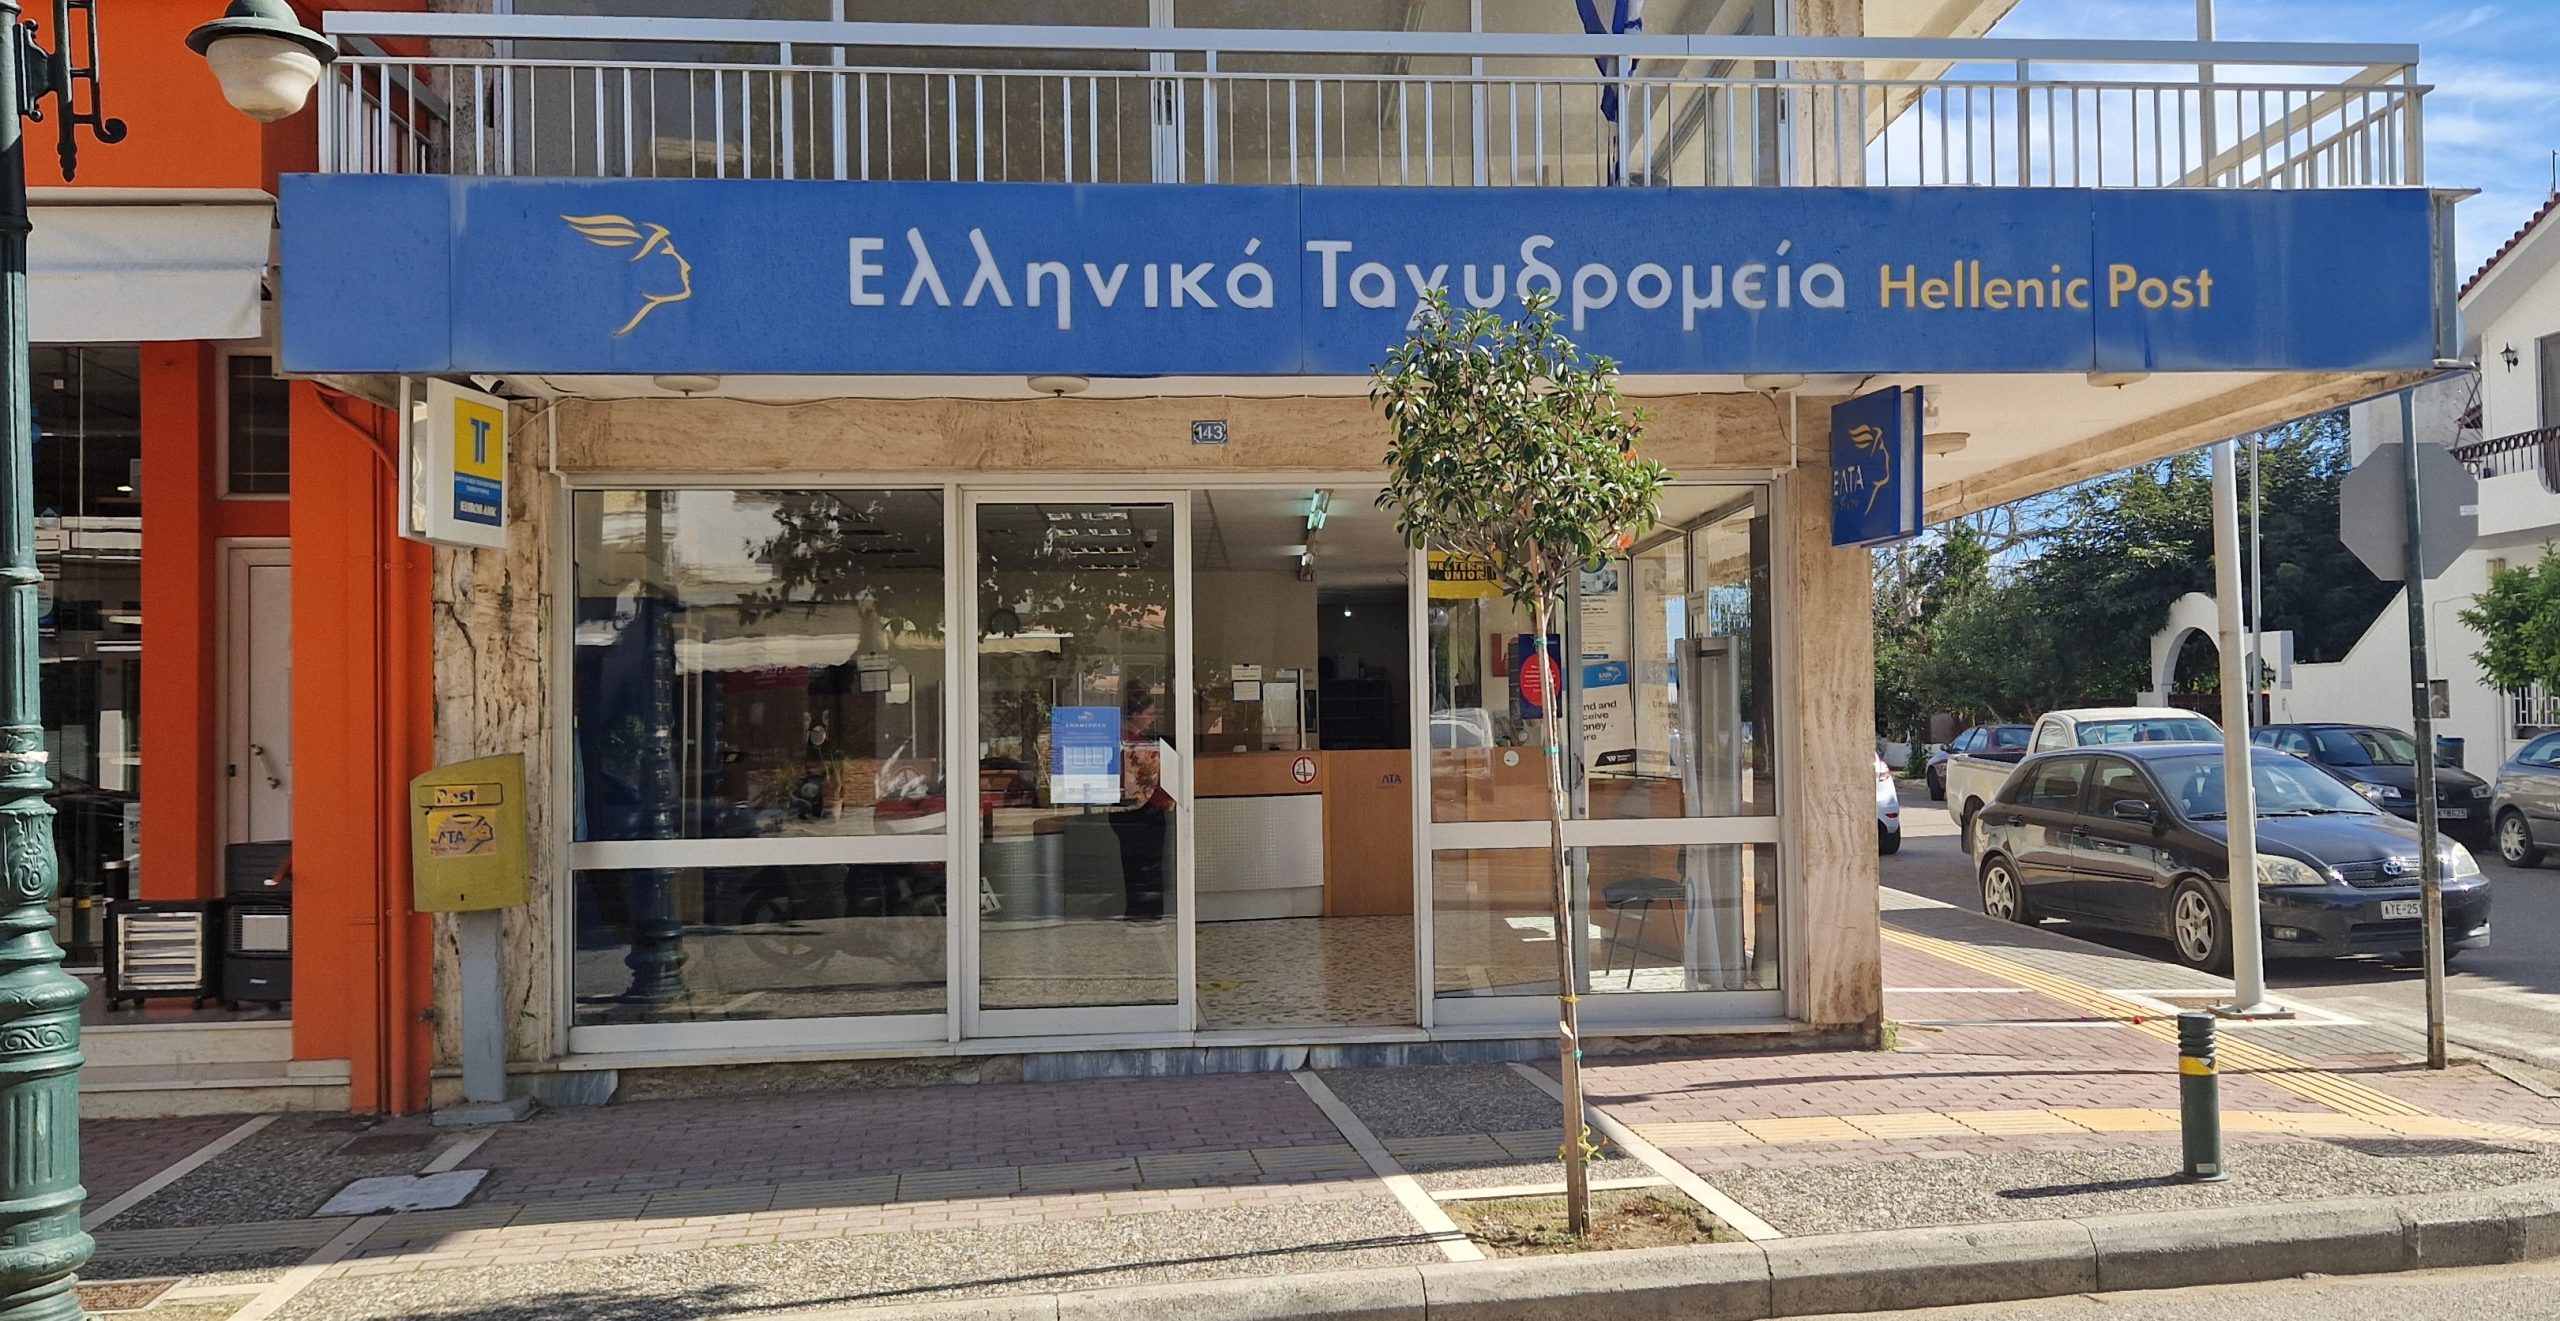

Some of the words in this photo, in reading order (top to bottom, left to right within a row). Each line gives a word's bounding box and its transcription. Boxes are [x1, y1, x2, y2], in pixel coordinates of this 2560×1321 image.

[849, 227, 1274, 331] Ελληνικά
[1306, 234, 1845, 331] Ταχυδρομεία
[1879, 260, 2088, 309] Hellenic
[2108, 264, 2213, 309] Post
[1195, 424, 1224, 440] 143
[1833, 465, 1865, 496] ΕΛΤΑ
[1428, 561, 1485, 571] WETERN
[1598, 700, 1617, 710] and
